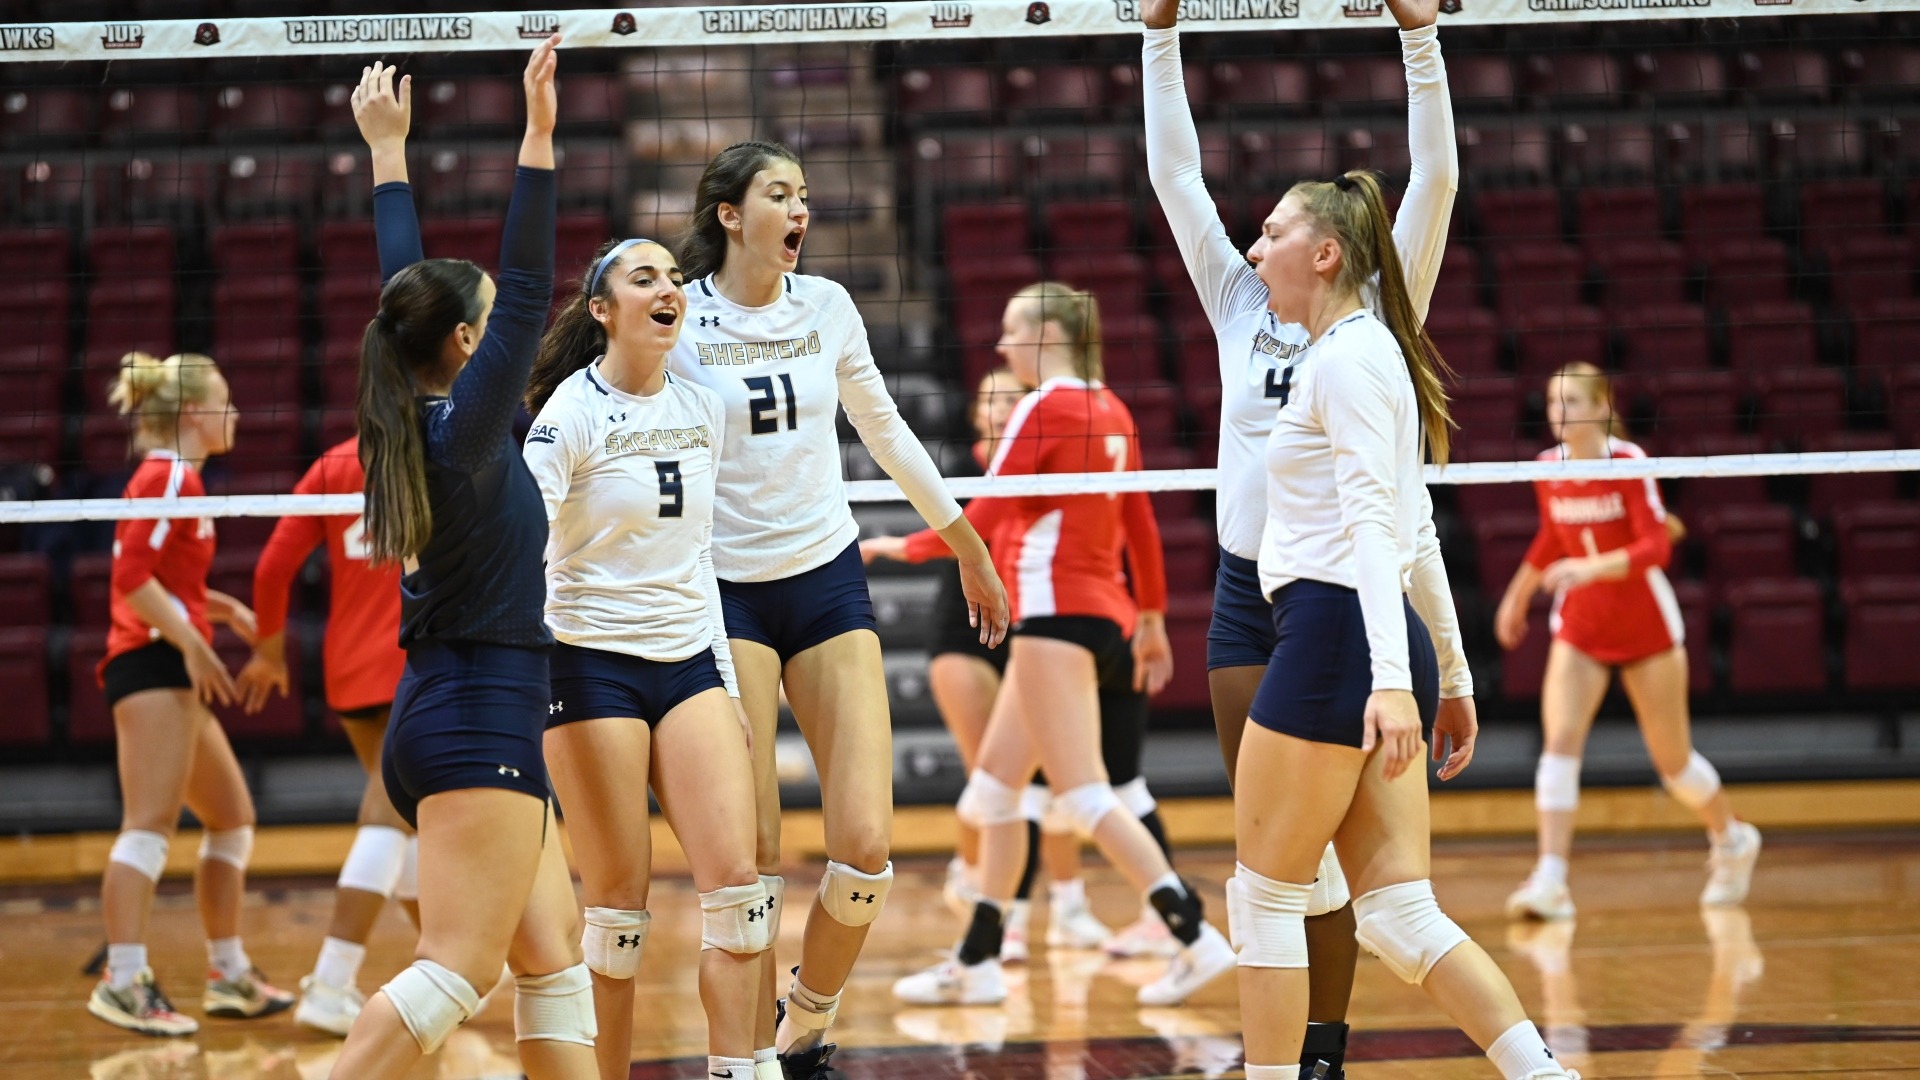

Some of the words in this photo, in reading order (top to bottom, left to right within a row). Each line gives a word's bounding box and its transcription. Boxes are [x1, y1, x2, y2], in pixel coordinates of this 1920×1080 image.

[698, 9, 803, 33] CRIMSON
[806, 6, 887, 31] HAWKS
[1220, 0, 1299, 20] HAWKS
[284, 19, 388, 43] CRIMSON
[391, 17, 472, 41] HAWKS
[696, 330, 821, 365] SHEPHERD
[741, 372, 798, 436] 21
[1264, 366, 1294, 409] 4
[1104, 432, 1128, 501] 7
[653, 461, 684, 519] 9
